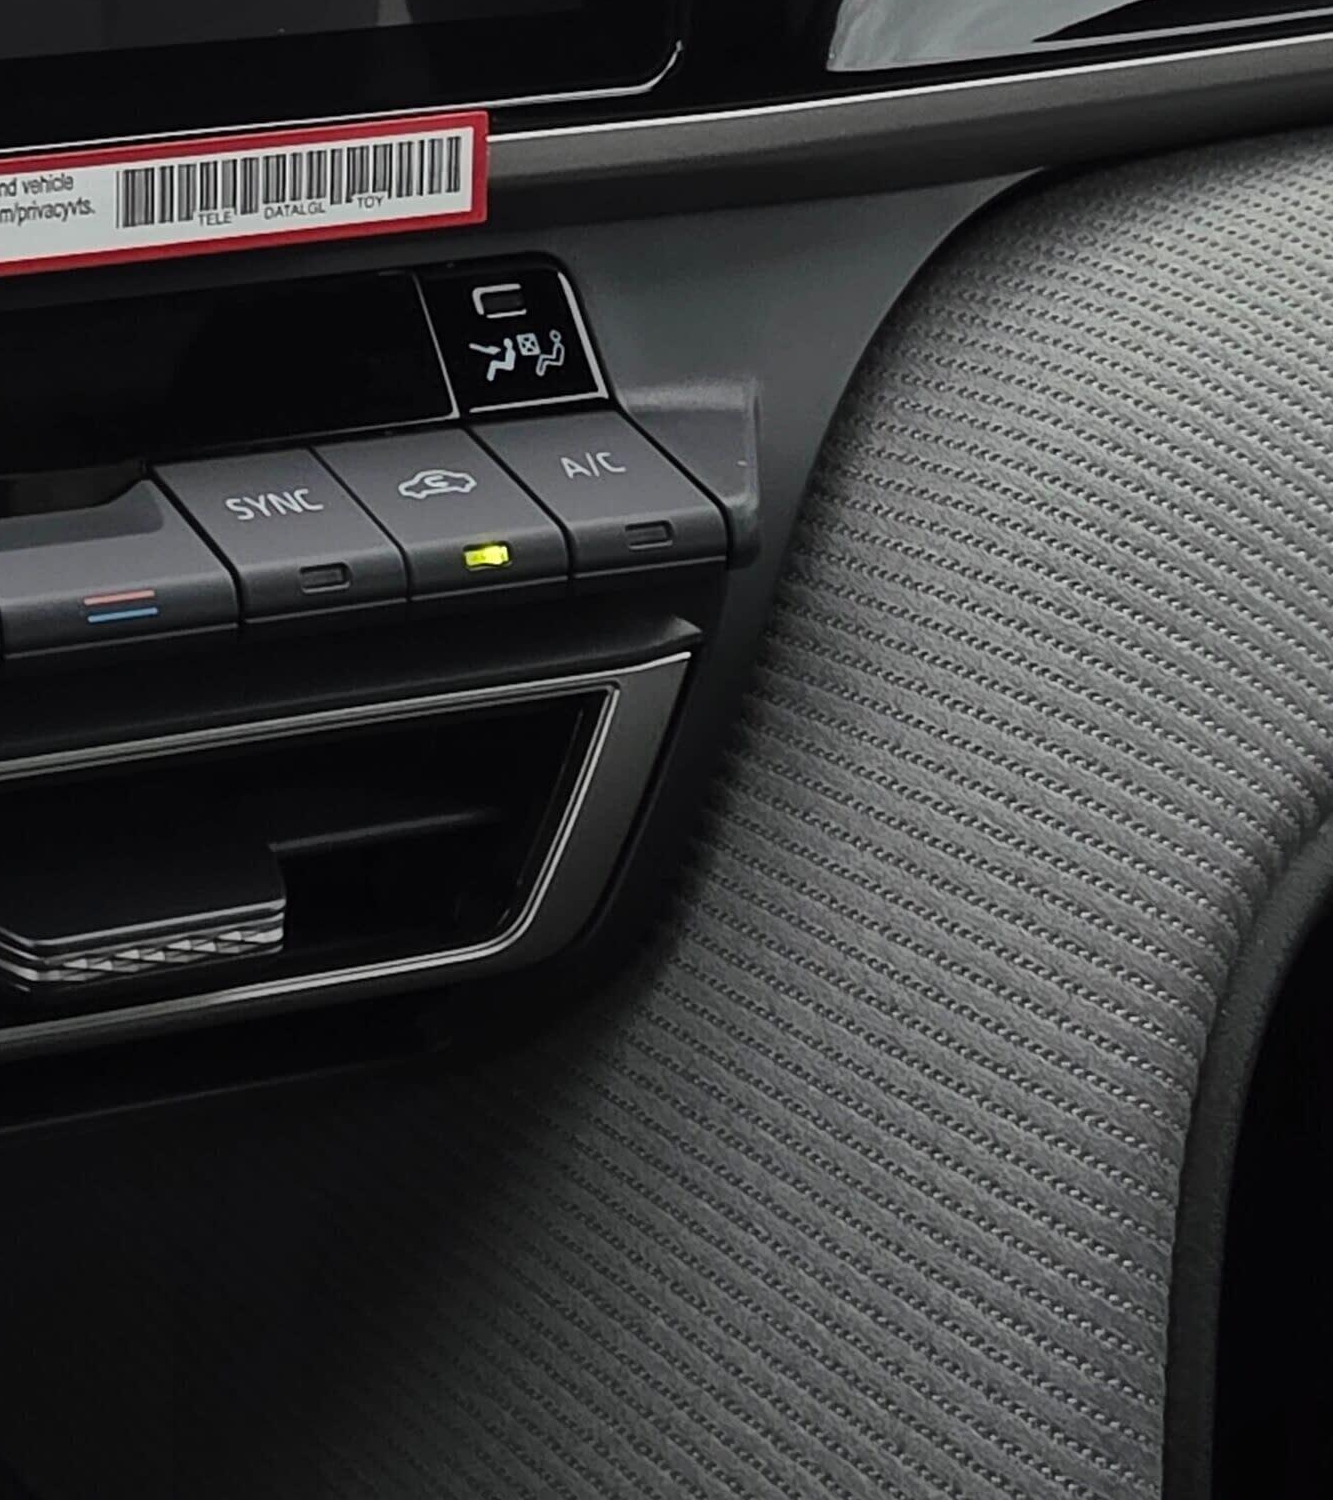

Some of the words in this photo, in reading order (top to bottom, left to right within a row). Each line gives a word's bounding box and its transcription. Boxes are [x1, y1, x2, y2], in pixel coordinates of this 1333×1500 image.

[22, 173, 74, 194] vehicle
[198, 211, 232, 227] TELE
[356, 196, 384, 209] TOY
[560, 450, 627, 480] A/C
[225, 488, 325, 521] SYNC
